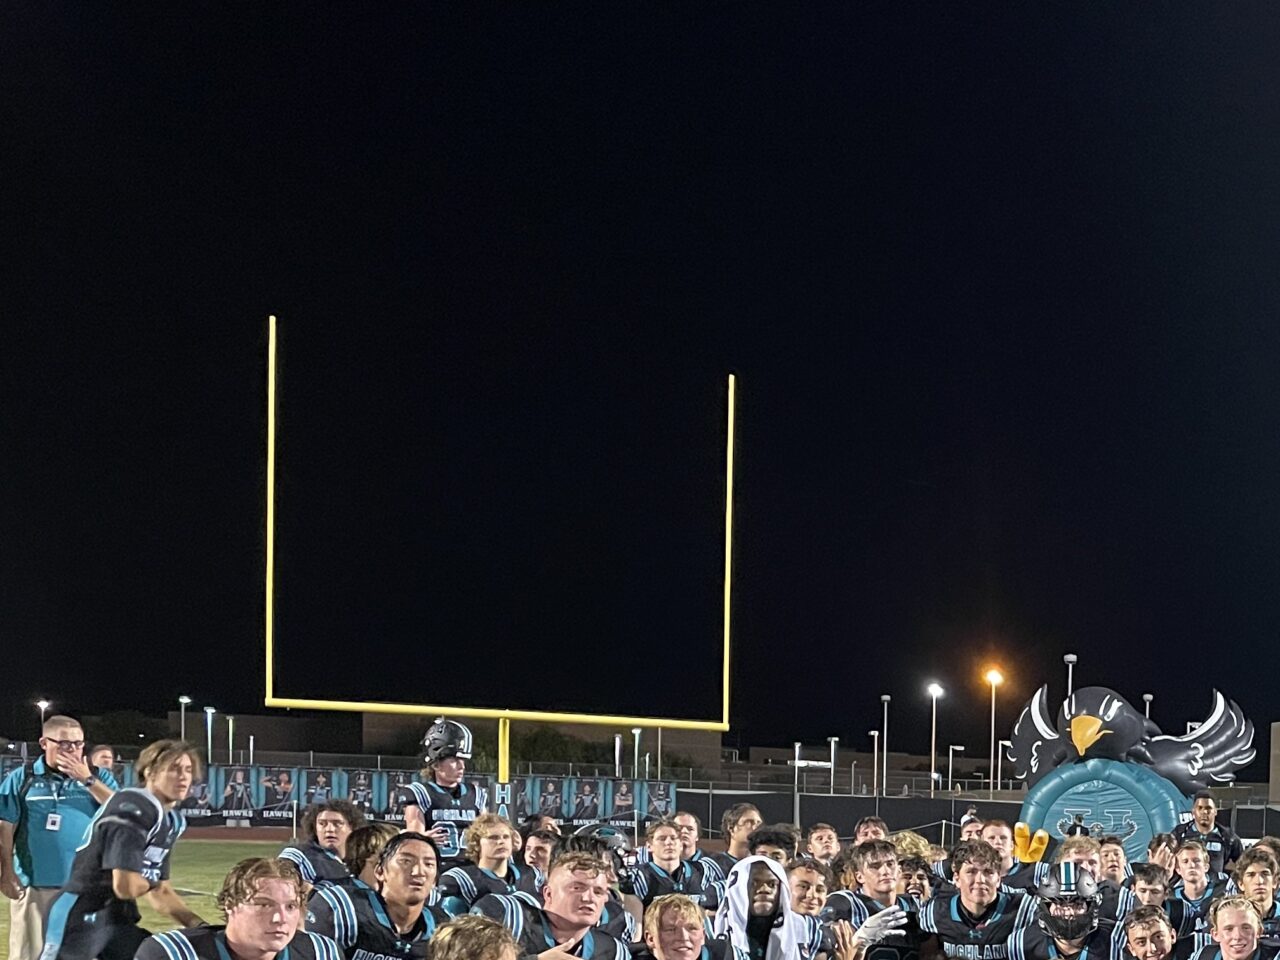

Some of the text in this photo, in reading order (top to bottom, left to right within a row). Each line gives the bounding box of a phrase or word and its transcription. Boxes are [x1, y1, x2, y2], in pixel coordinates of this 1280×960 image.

[222, 809, 254, 818] HAWKS
[262, 810, 293, 819] HAWKS
[384, 813, 407, 822] HAW
